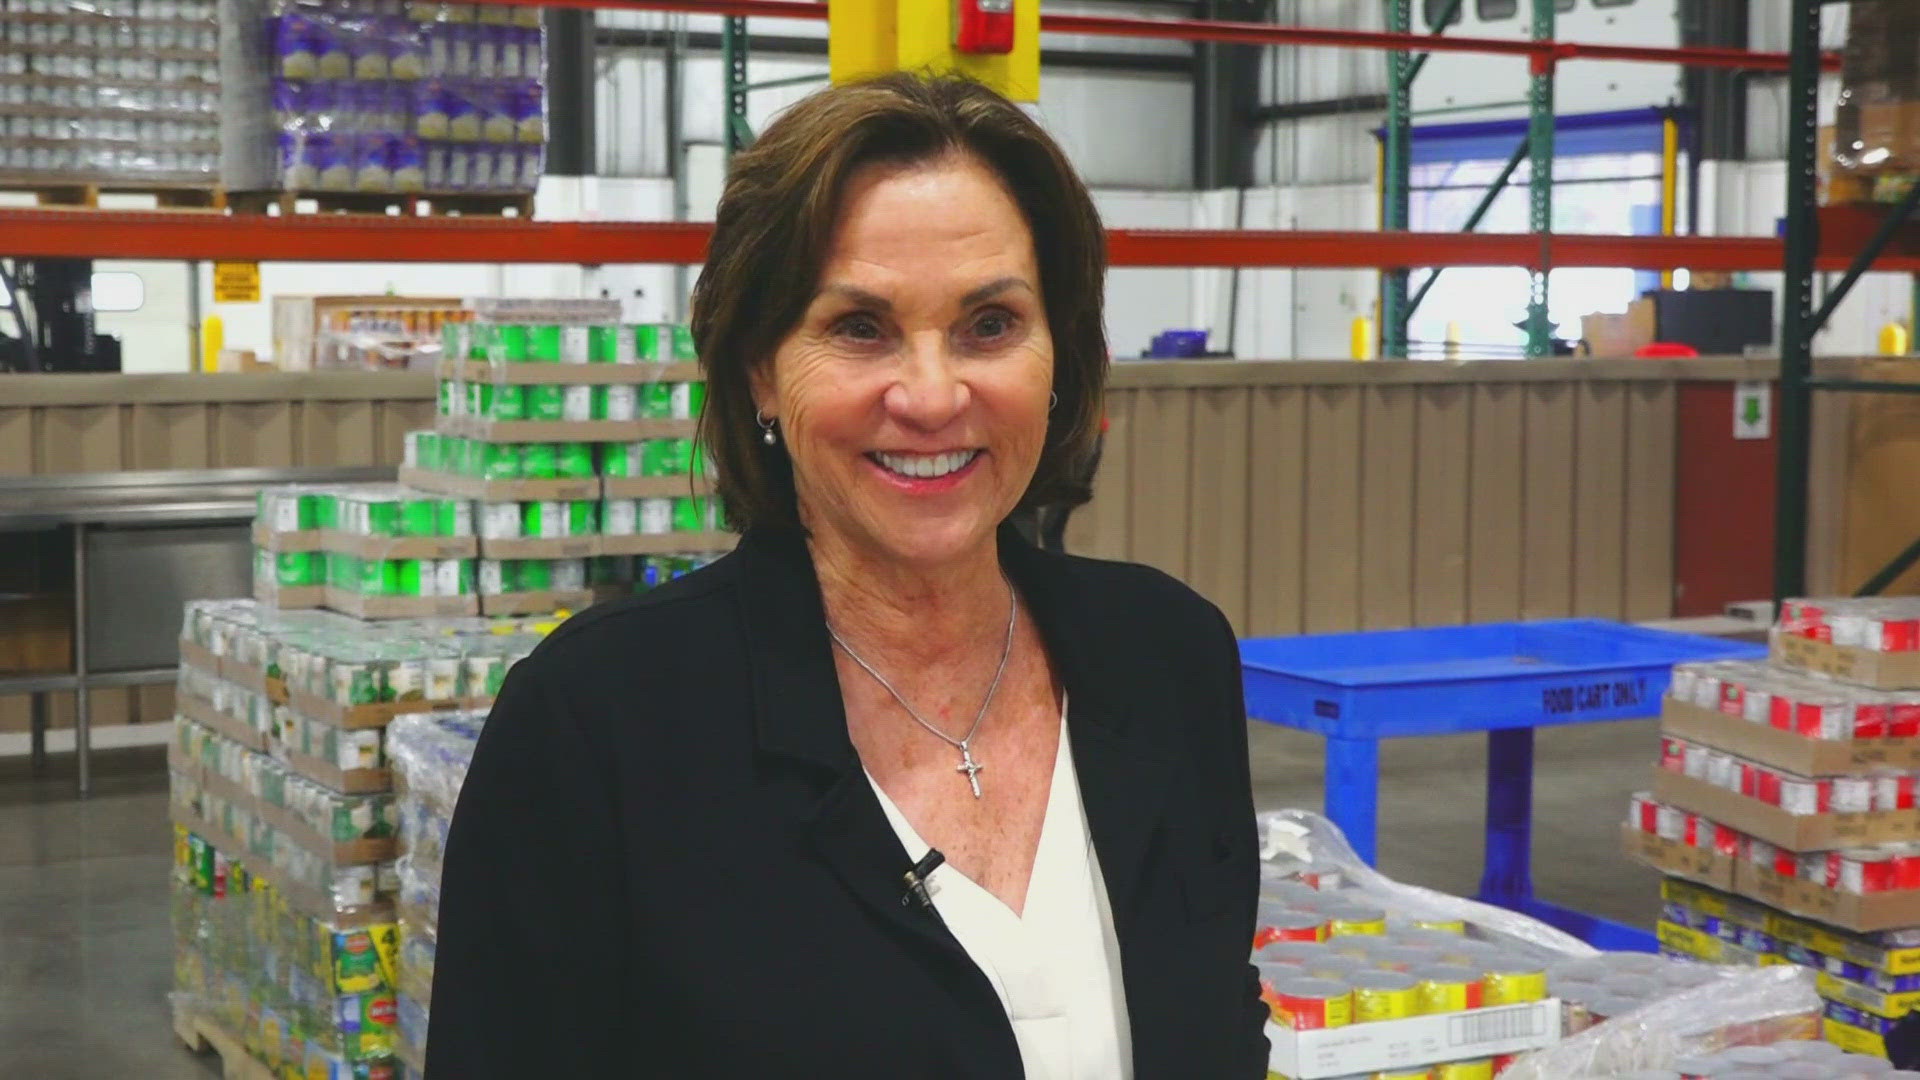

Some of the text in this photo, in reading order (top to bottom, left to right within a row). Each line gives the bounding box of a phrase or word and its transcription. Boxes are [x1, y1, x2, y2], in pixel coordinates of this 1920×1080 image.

[1542, 678, 1647, 713] FOOD CART ONLY
